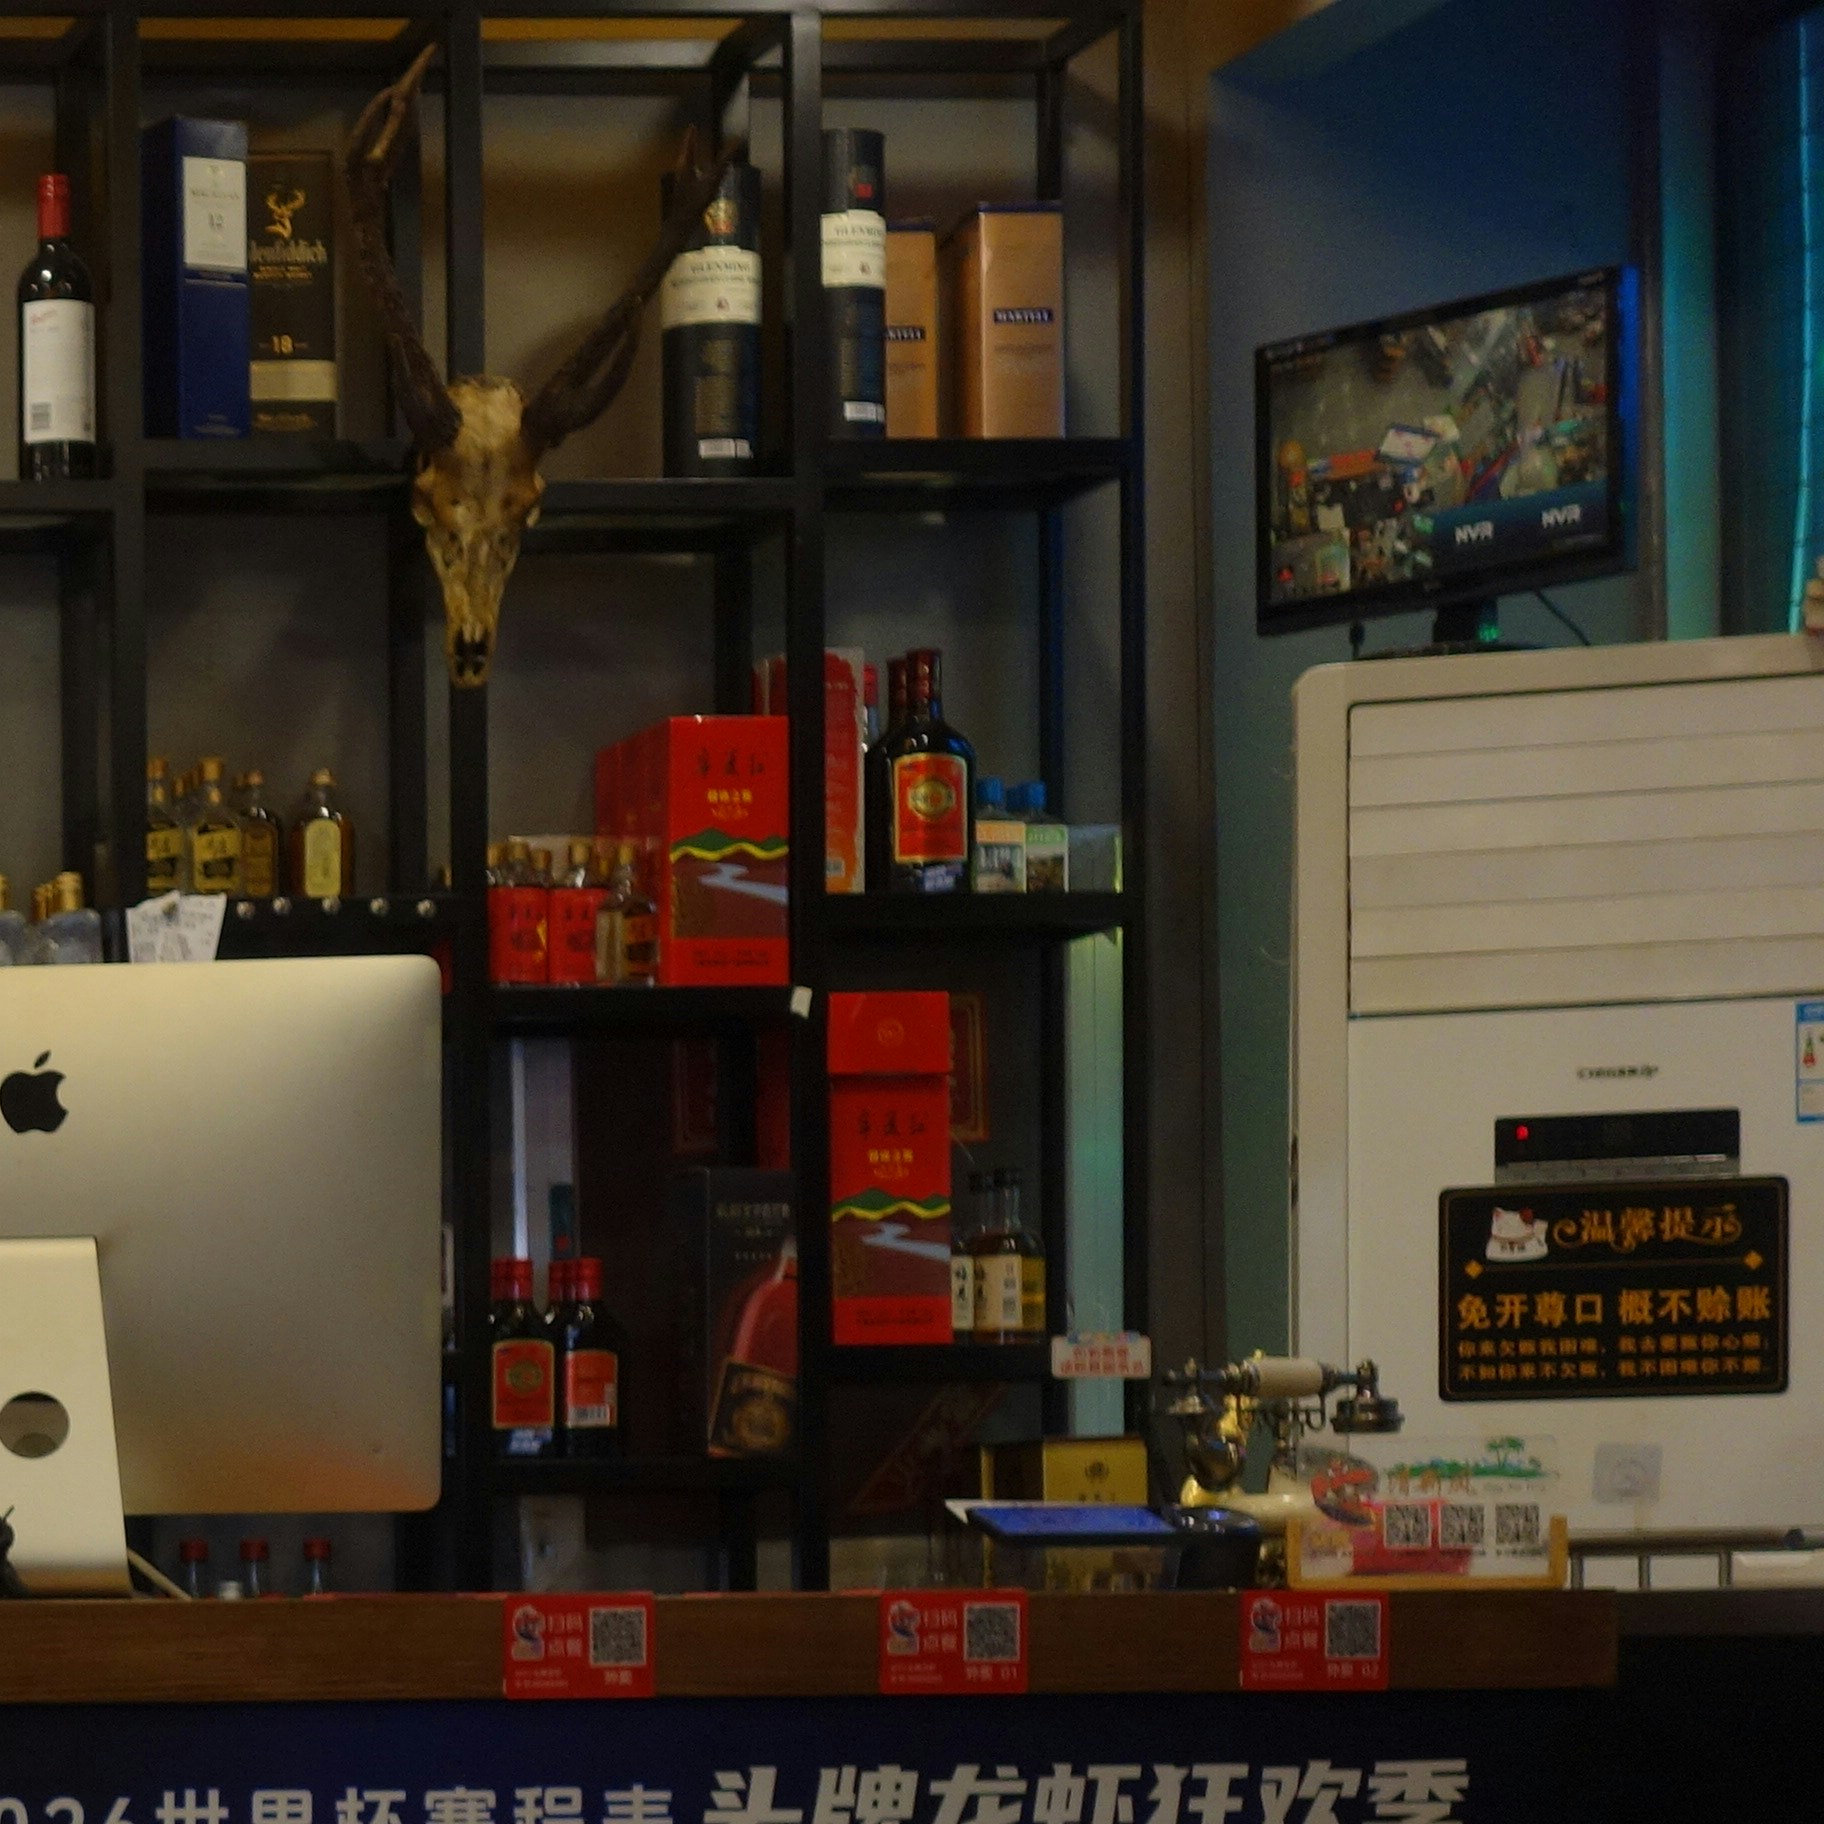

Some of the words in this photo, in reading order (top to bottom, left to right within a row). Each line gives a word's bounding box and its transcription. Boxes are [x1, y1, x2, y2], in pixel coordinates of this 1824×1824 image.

[1554, 1203, 1743, 1254] 温馨提示
[1457, 1291, 1604, 1330] 免开尊口
